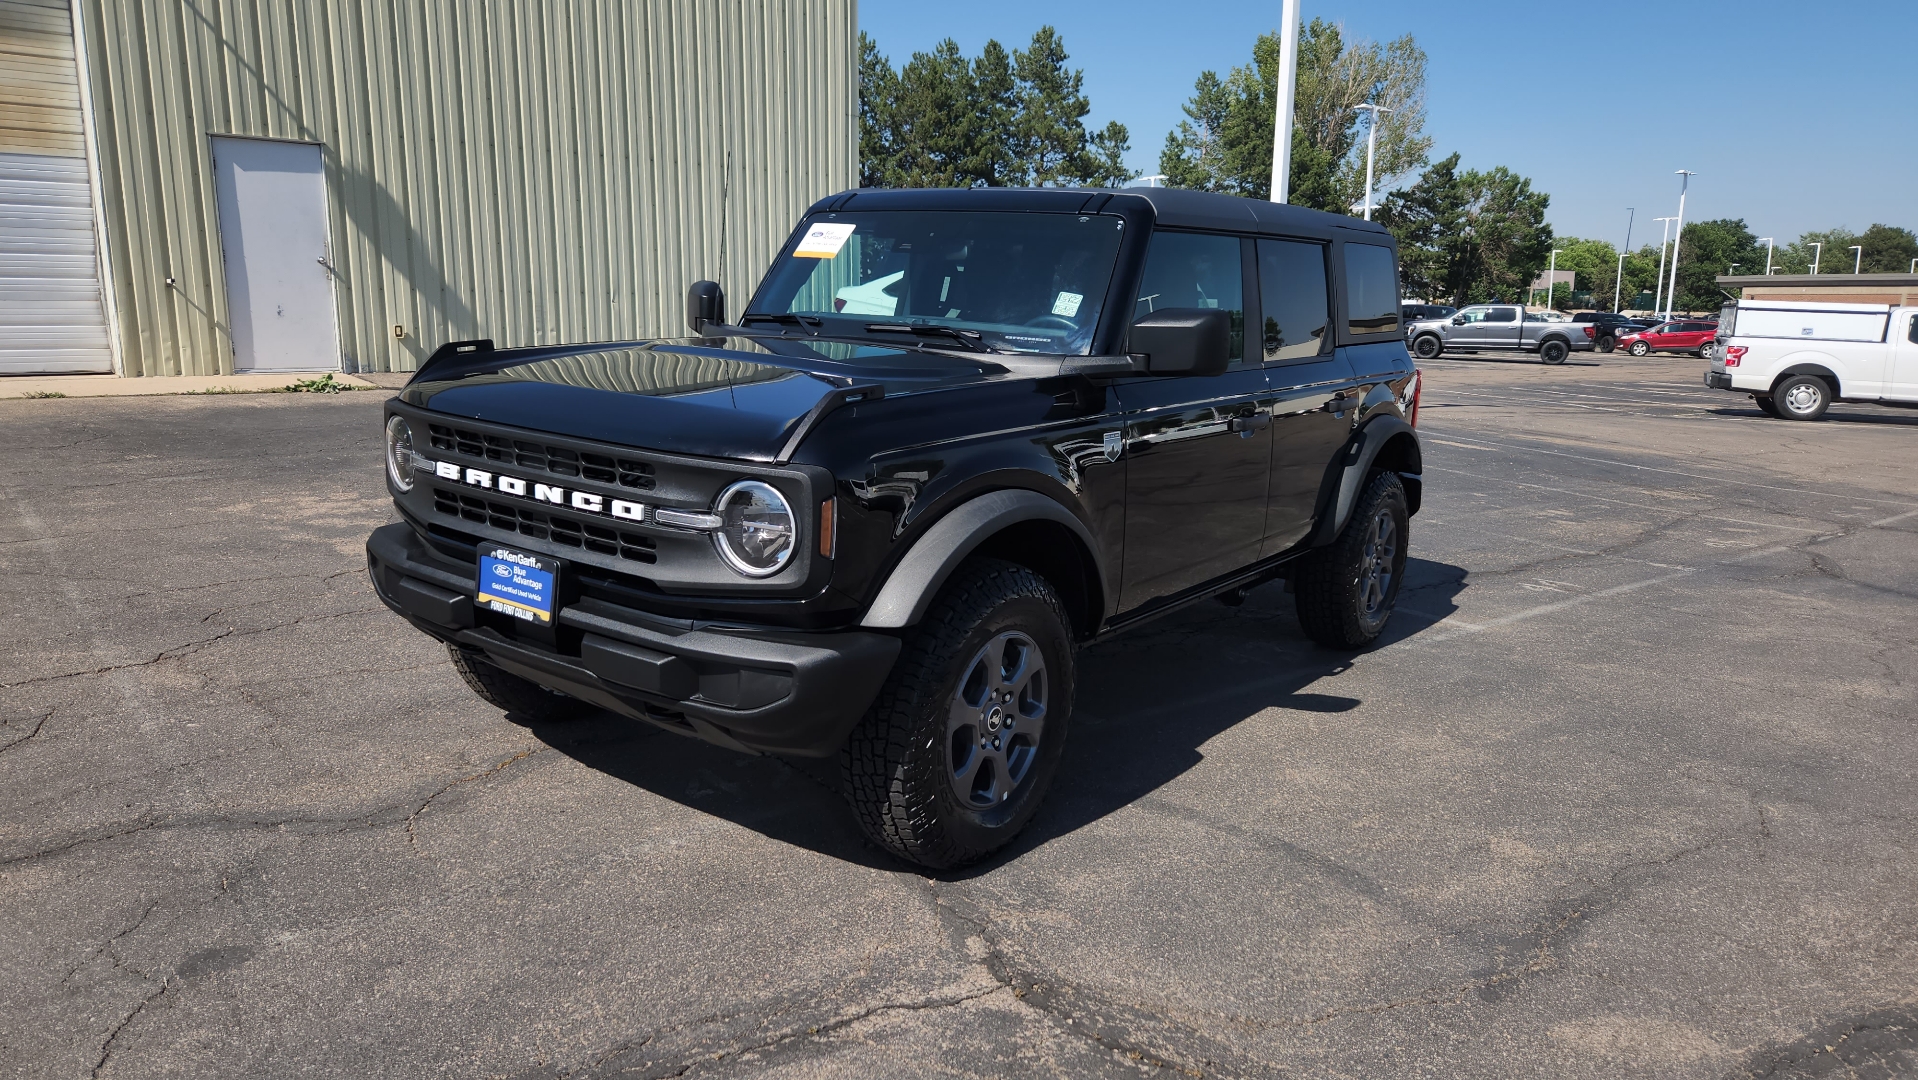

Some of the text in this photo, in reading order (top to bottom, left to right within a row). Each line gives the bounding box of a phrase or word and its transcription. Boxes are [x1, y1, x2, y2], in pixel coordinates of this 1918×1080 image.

[436, 461, 645, 521] BRONCO
[513, 566, 527, 576] Blue
[513, 575, 543, 590] Advantage
[517, 589, 528, 598] Used
[527, 592, 542, 602] Vehicle
[490, 600, 534, 622] FORD FORT COLLINS
[936, 703, 956, 817] COOPER
